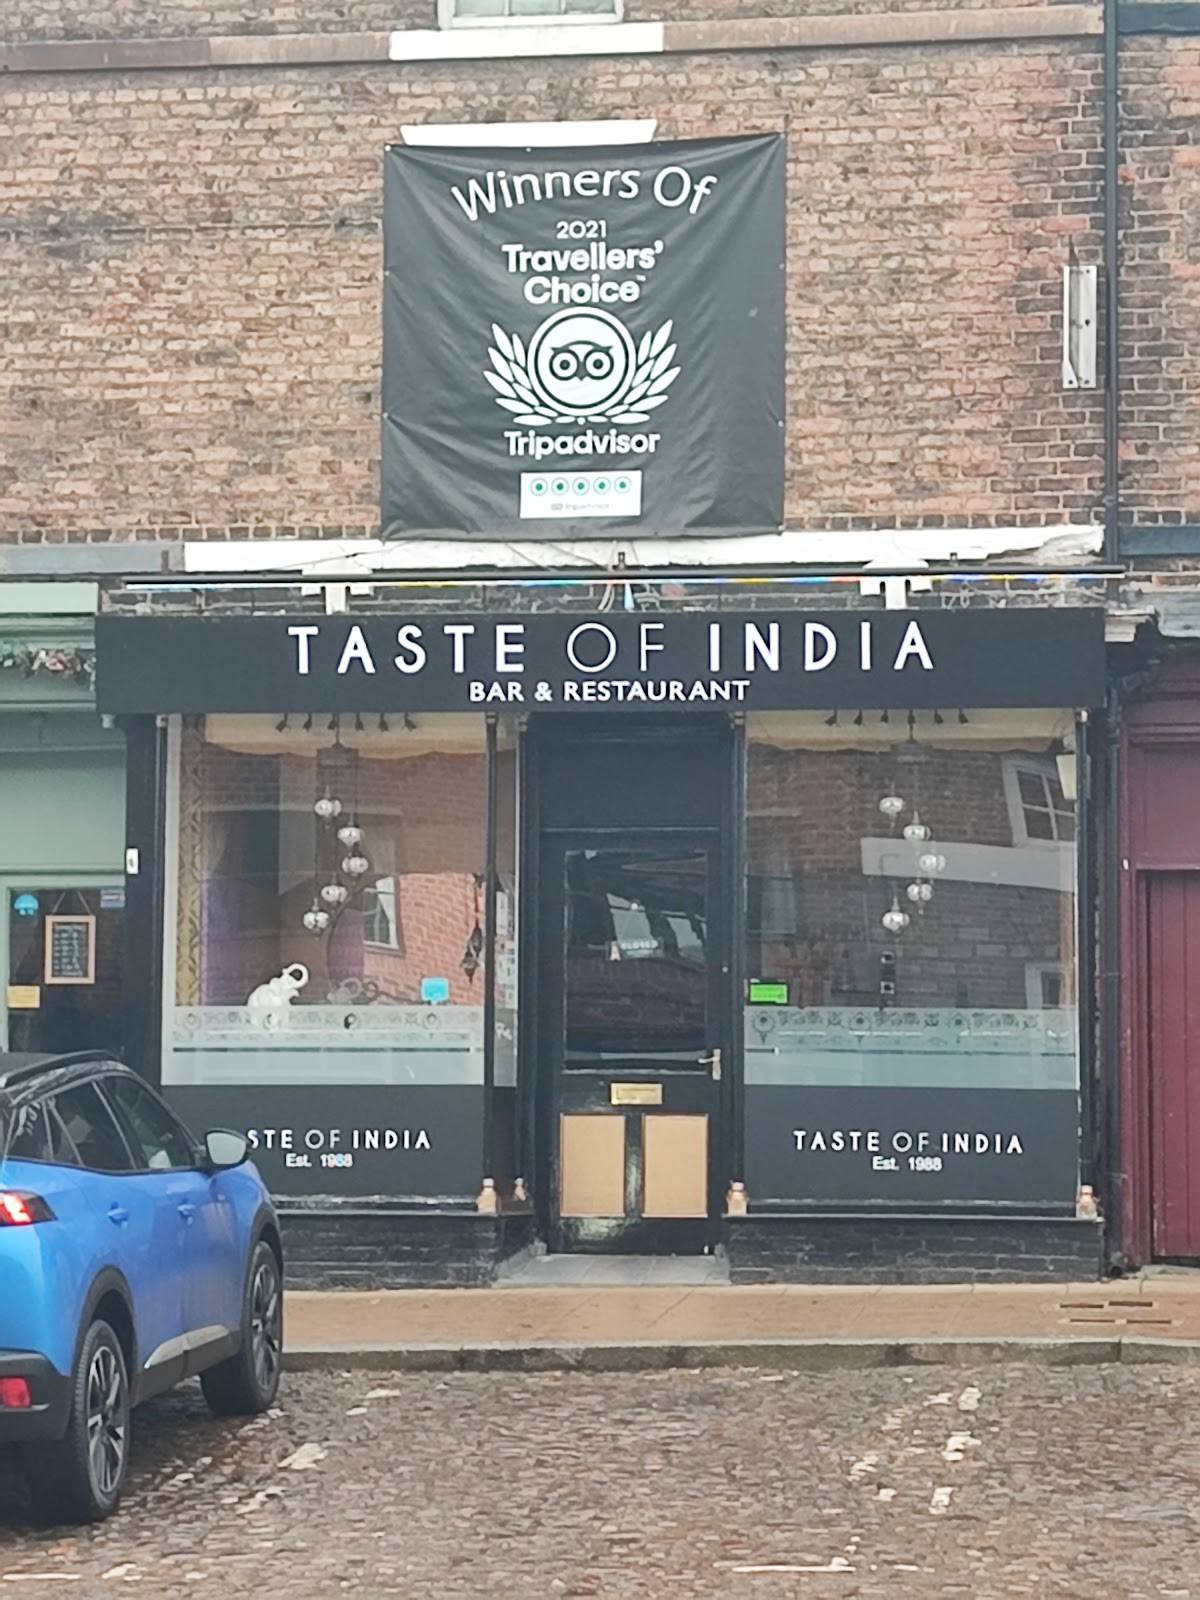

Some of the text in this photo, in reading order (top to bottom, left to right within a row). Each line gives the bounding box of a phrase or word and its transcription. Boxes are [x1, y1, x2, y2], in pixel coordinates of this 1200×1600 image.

[451, 166, 718, 221] Winners Of
[555, 219, 607, 239] 2021
[503, 428, 661, 460] Tripadvisor
[287, 620, 934, 674] TASTE OF INDIA
[469, 680, 750, 702] BAR & RESTAURANT
[247, 1129, 431, 1149] STE OF INDIA
[793, 1130, 1023, 1154] TASTE OF INDIA
[872, 1155, 900, 1171] Est.
